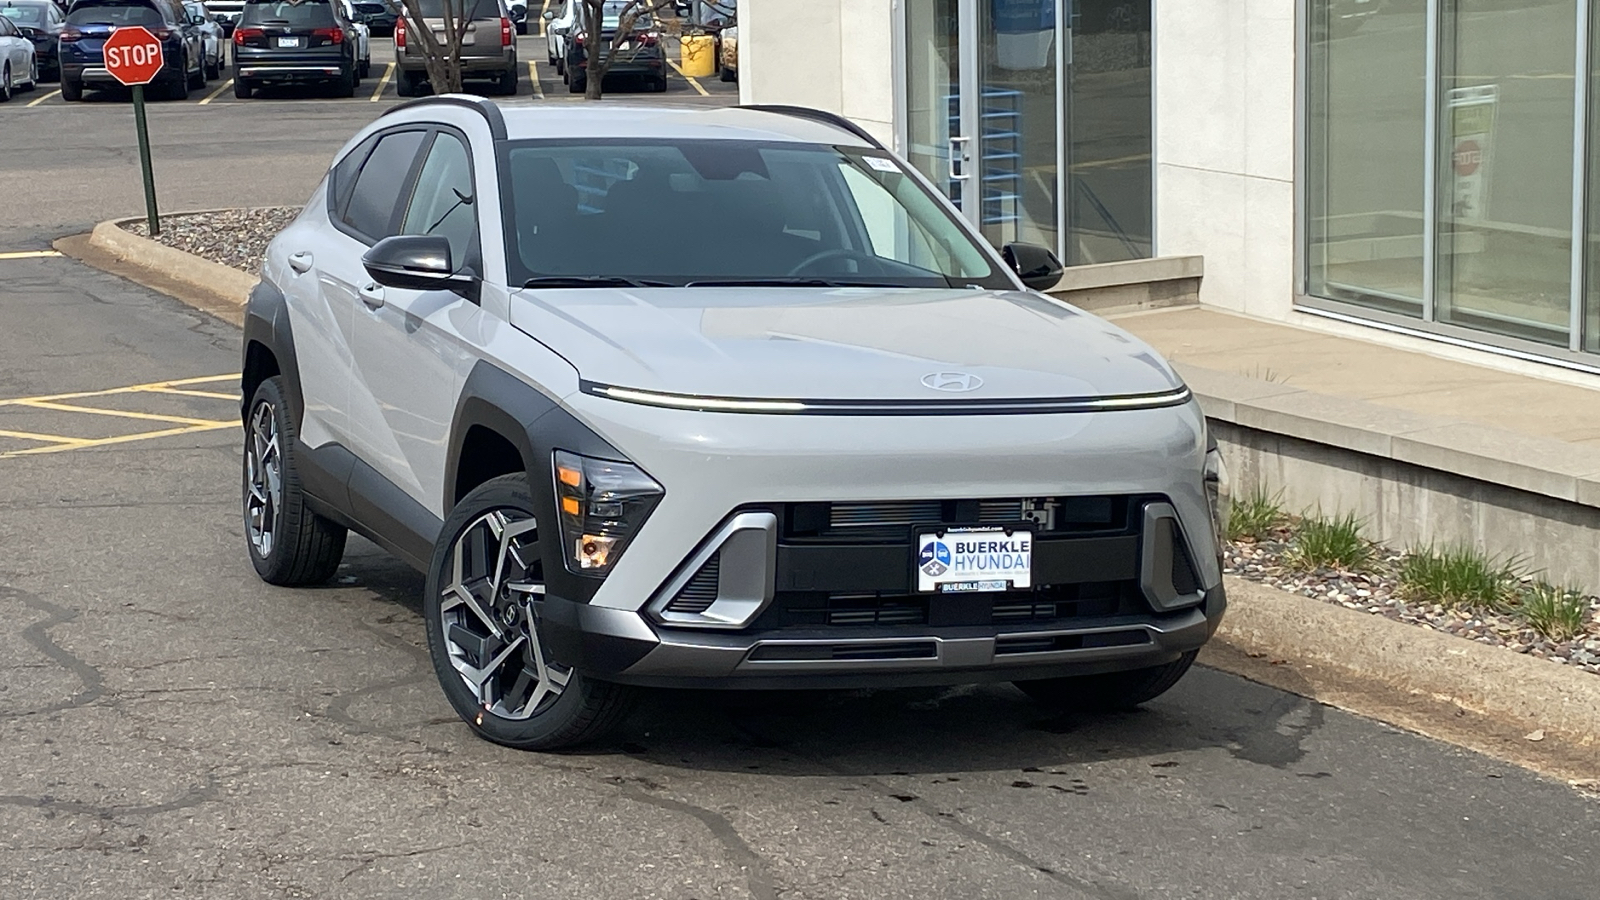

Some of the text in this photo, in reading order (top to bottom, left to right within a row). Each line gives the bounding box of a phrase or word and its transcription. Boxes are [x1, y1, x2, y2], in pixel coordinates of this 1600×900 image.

[108, 43, 158, 68] STOP
[955, 541, 1030, 554] BUERKLE
[955, 554, 1030, 571] HYUNDAI
[943, 582, 1005, 592] BUERKLE HYUNDAI
